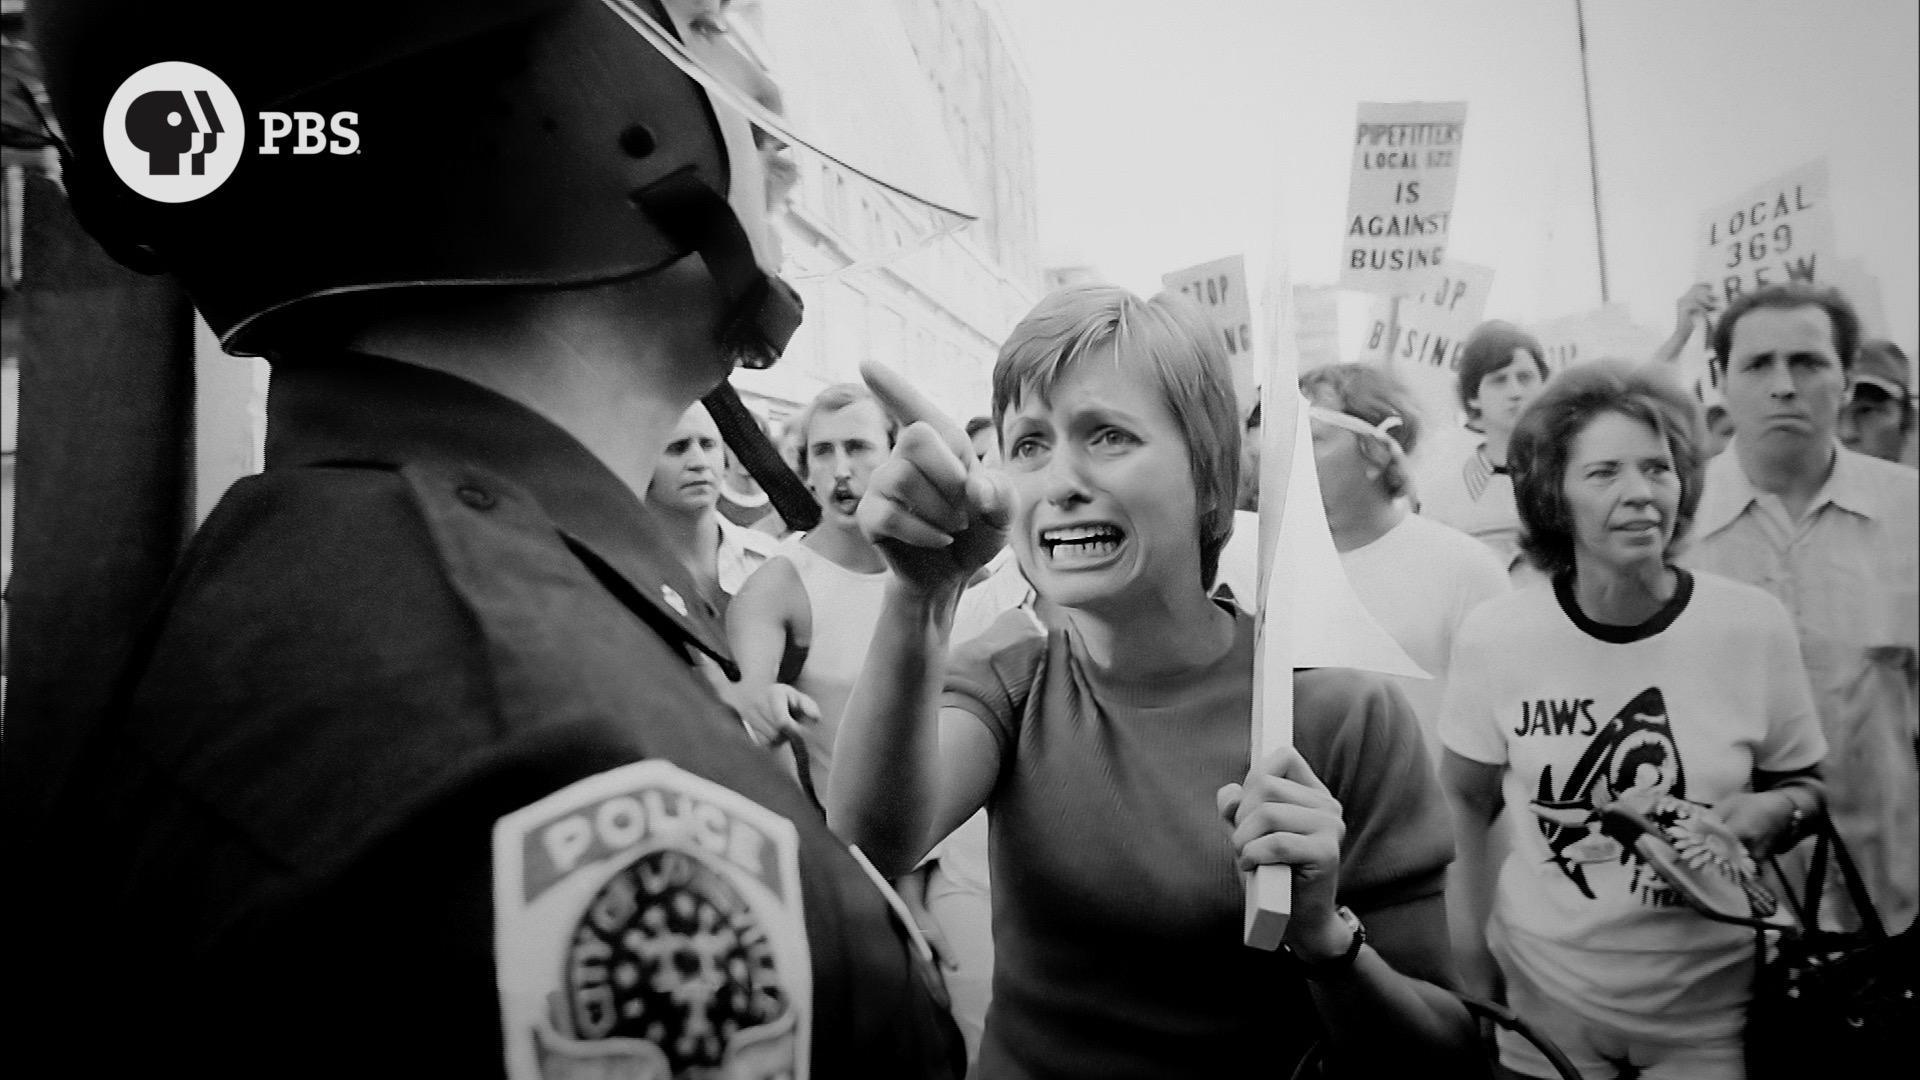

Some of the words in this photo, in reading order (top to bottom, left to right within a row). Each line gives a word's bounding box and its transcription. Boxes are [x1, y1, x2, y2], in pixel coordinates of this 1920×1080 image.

[1363, 151, 1417, 170] LOCAL
[1395, 181, 1419, 203] IS
[1350, 210, 1449, 236] AGAINST
[1710, 184, 1814, 246] LOCAL
[1351, 246, 1443, 271] BUSING
[1726, 223, 1793, 268] 369
[1515, 699, 1597, 737] JAWS
[542, 790, 762, 873] POLICE
